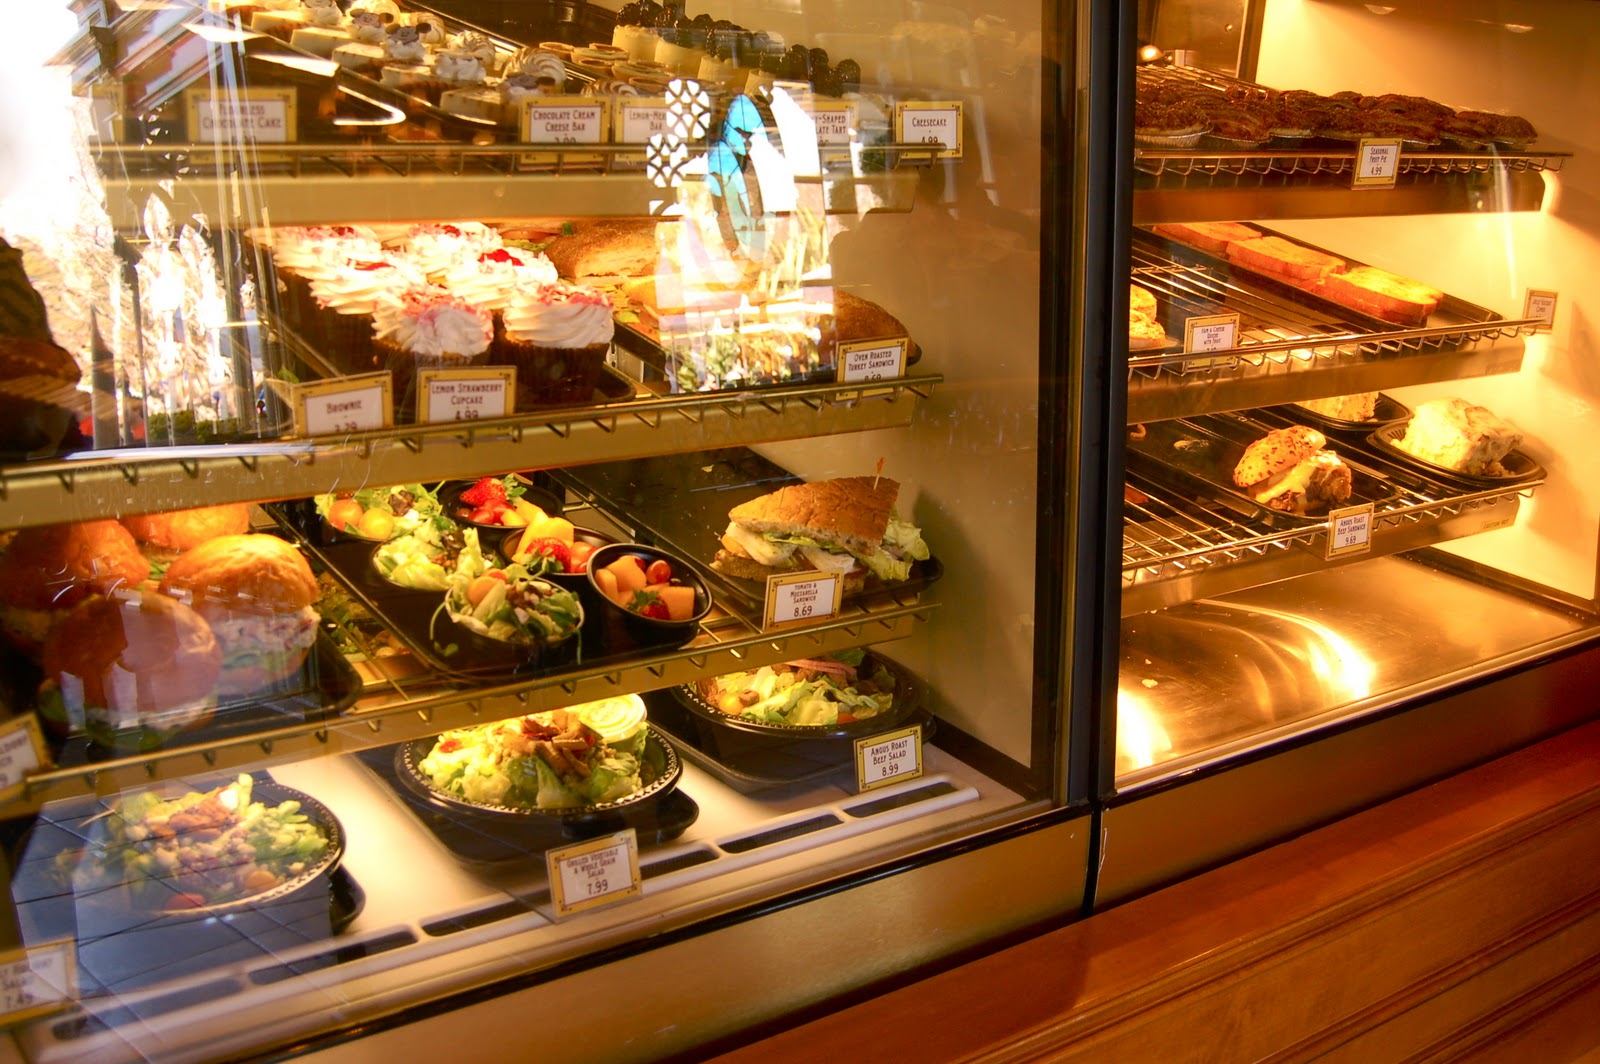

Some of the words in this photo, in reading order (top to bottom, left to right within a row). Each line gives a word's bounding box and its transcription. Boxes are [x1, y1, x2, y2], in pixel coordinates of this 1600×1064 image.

[533, 110, 570, 120] CHOCOLATE
[573, 110, 596, 120] CREAM
[258, 116, 281, 128] CAKE
[545, 122, 569, 132] CHEESE
[572, 121, 586, 131] BAR
[649, 121, 662, 131] BAR
[912, 117, 947, 127] CHEESECAKE
[832, 124, 846, 134] TART
[1370, 147, 1389, 155] SEASONAL
[854, 353, 868, 362] OVEN
[870, 350, 892, 360] ROASTED
[848, 361, 866, 373] TURKEY
[868, 359, 895, 370] SANDWICH
[432, 384, 455, 394] LEMON
[458, 383, 503, 394] STRAWBERRY
[451, 395, 483, 406] CUPCAKE
[326, 400, 362, 414] BROWNIE
[790, 589, 818, 598] MOZZARELLA
[793, 595, 816, 604] SANDWICH
[793, 605, 813, 617] 8.69
[871, 744, 890, 757] ANGUS
[891, 740, 908, 751] ROAST
[873, 755, 887, 766] BEEF
[888, 750, 907, 761] SALAD
[881, 763, 899, 777] 8.99
[587, 879, 609, 895] 7.99
